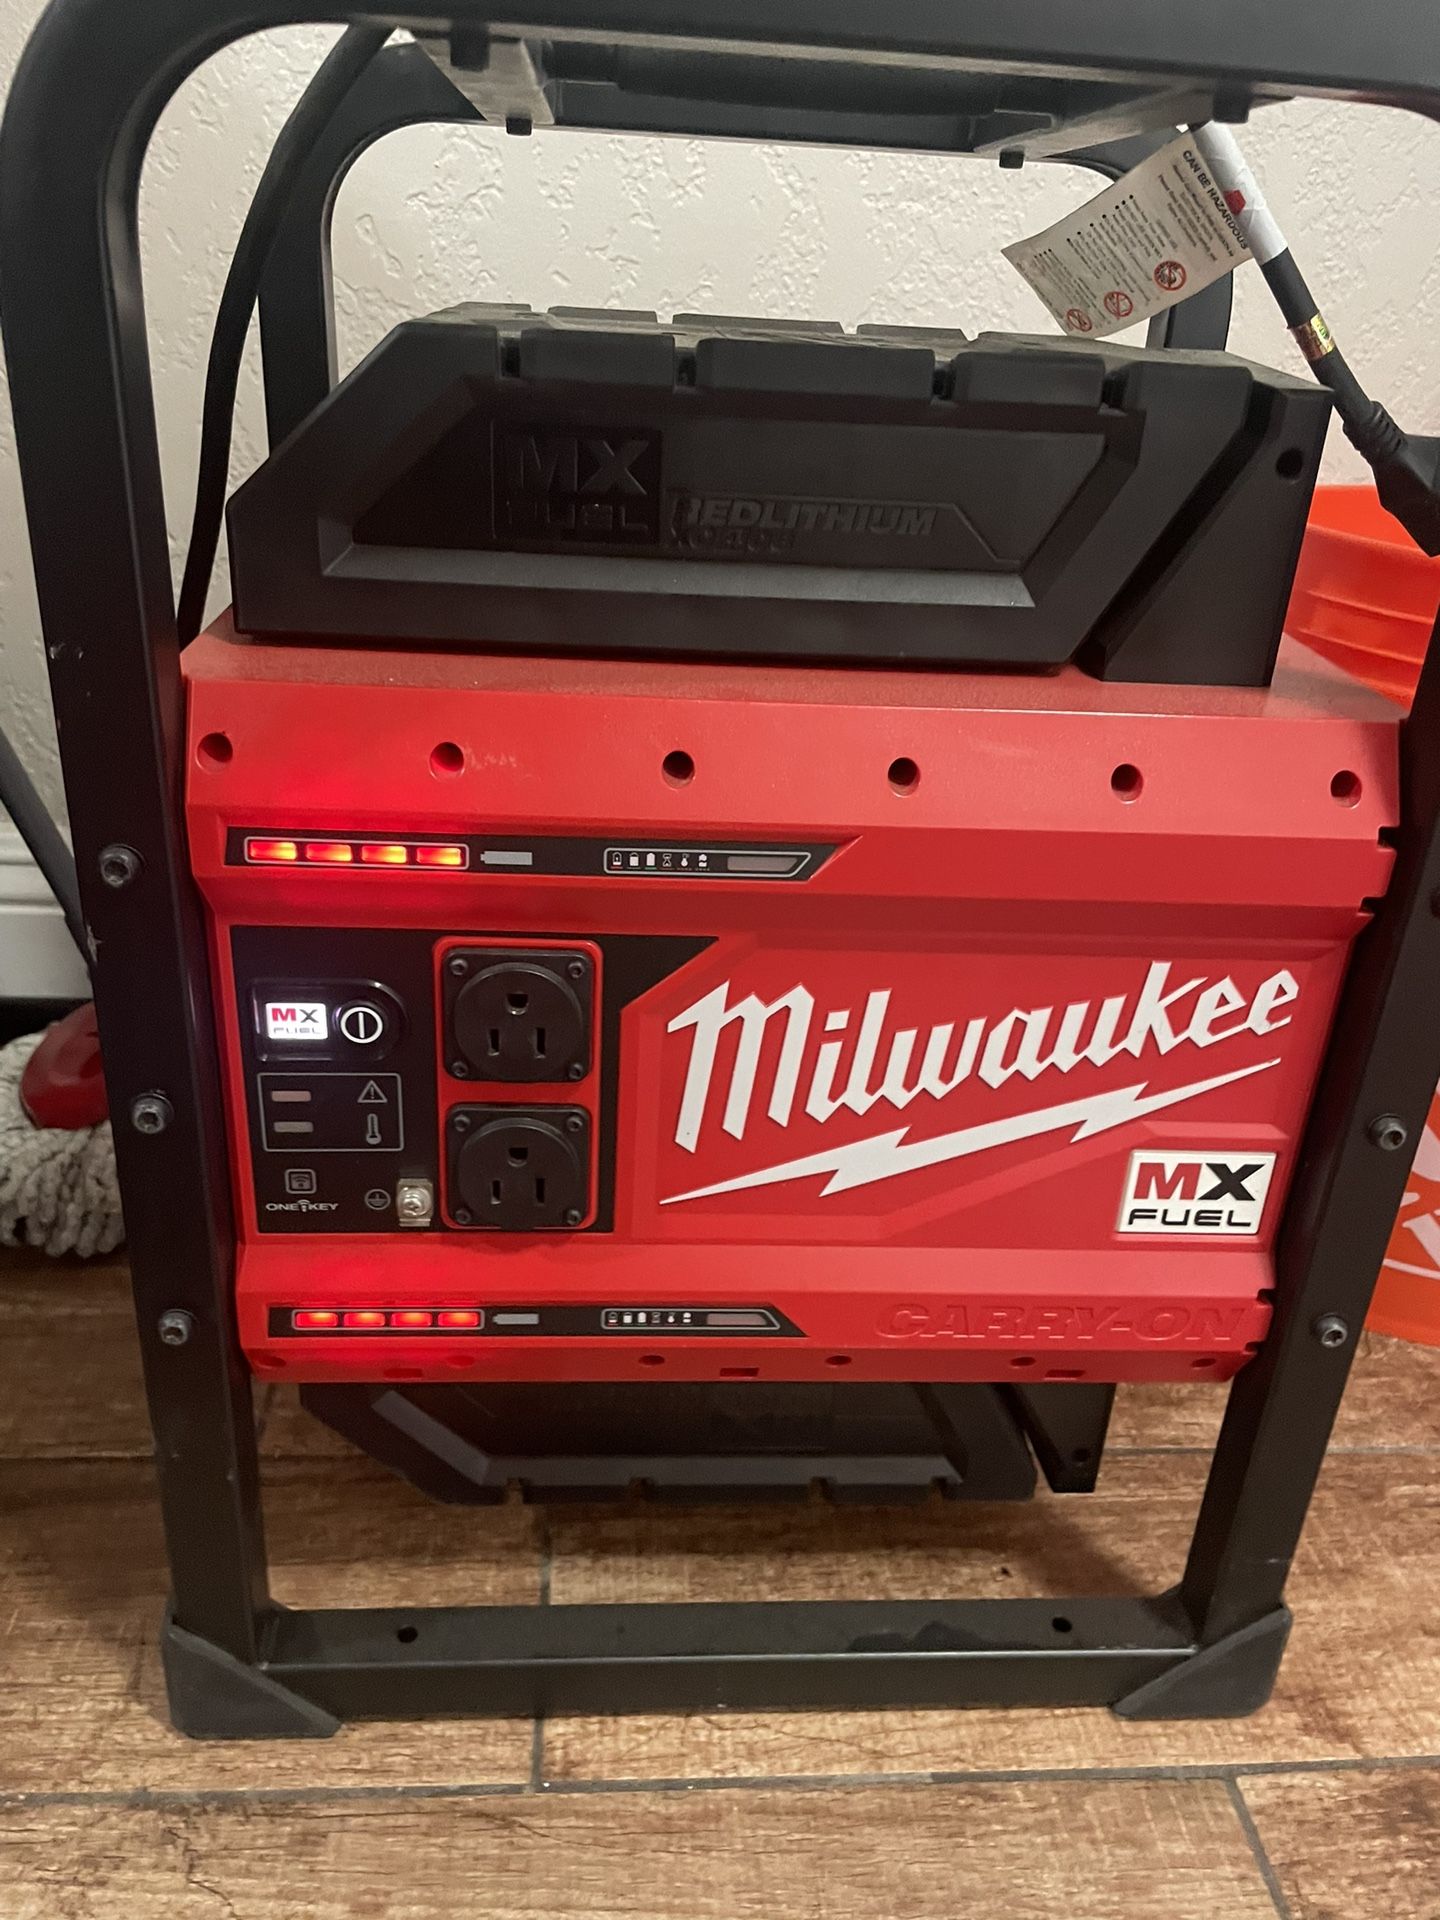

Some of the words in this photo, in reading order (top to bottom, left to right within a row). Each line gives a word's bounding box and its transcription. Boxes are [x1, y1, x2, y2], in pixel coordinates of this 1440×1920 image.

[1182, 150, 1200, 174] CAN
[1197, 173, 1211, 189] BE
[1208, 186, 1249, 250] HAZARDOUS
[503, 435, 650, 495] MX
[271, 1008, 319, 1024] MX
[273, 1027, 321, 1035] FUEL
[666, 961, 1300, 1155] Milwaukee
[1132, 1162, 1266, 1202] MX
[1127, 1208, 1252, 1228] FUEL
[875, 1302, 1248, 1342] CARRY-ON
